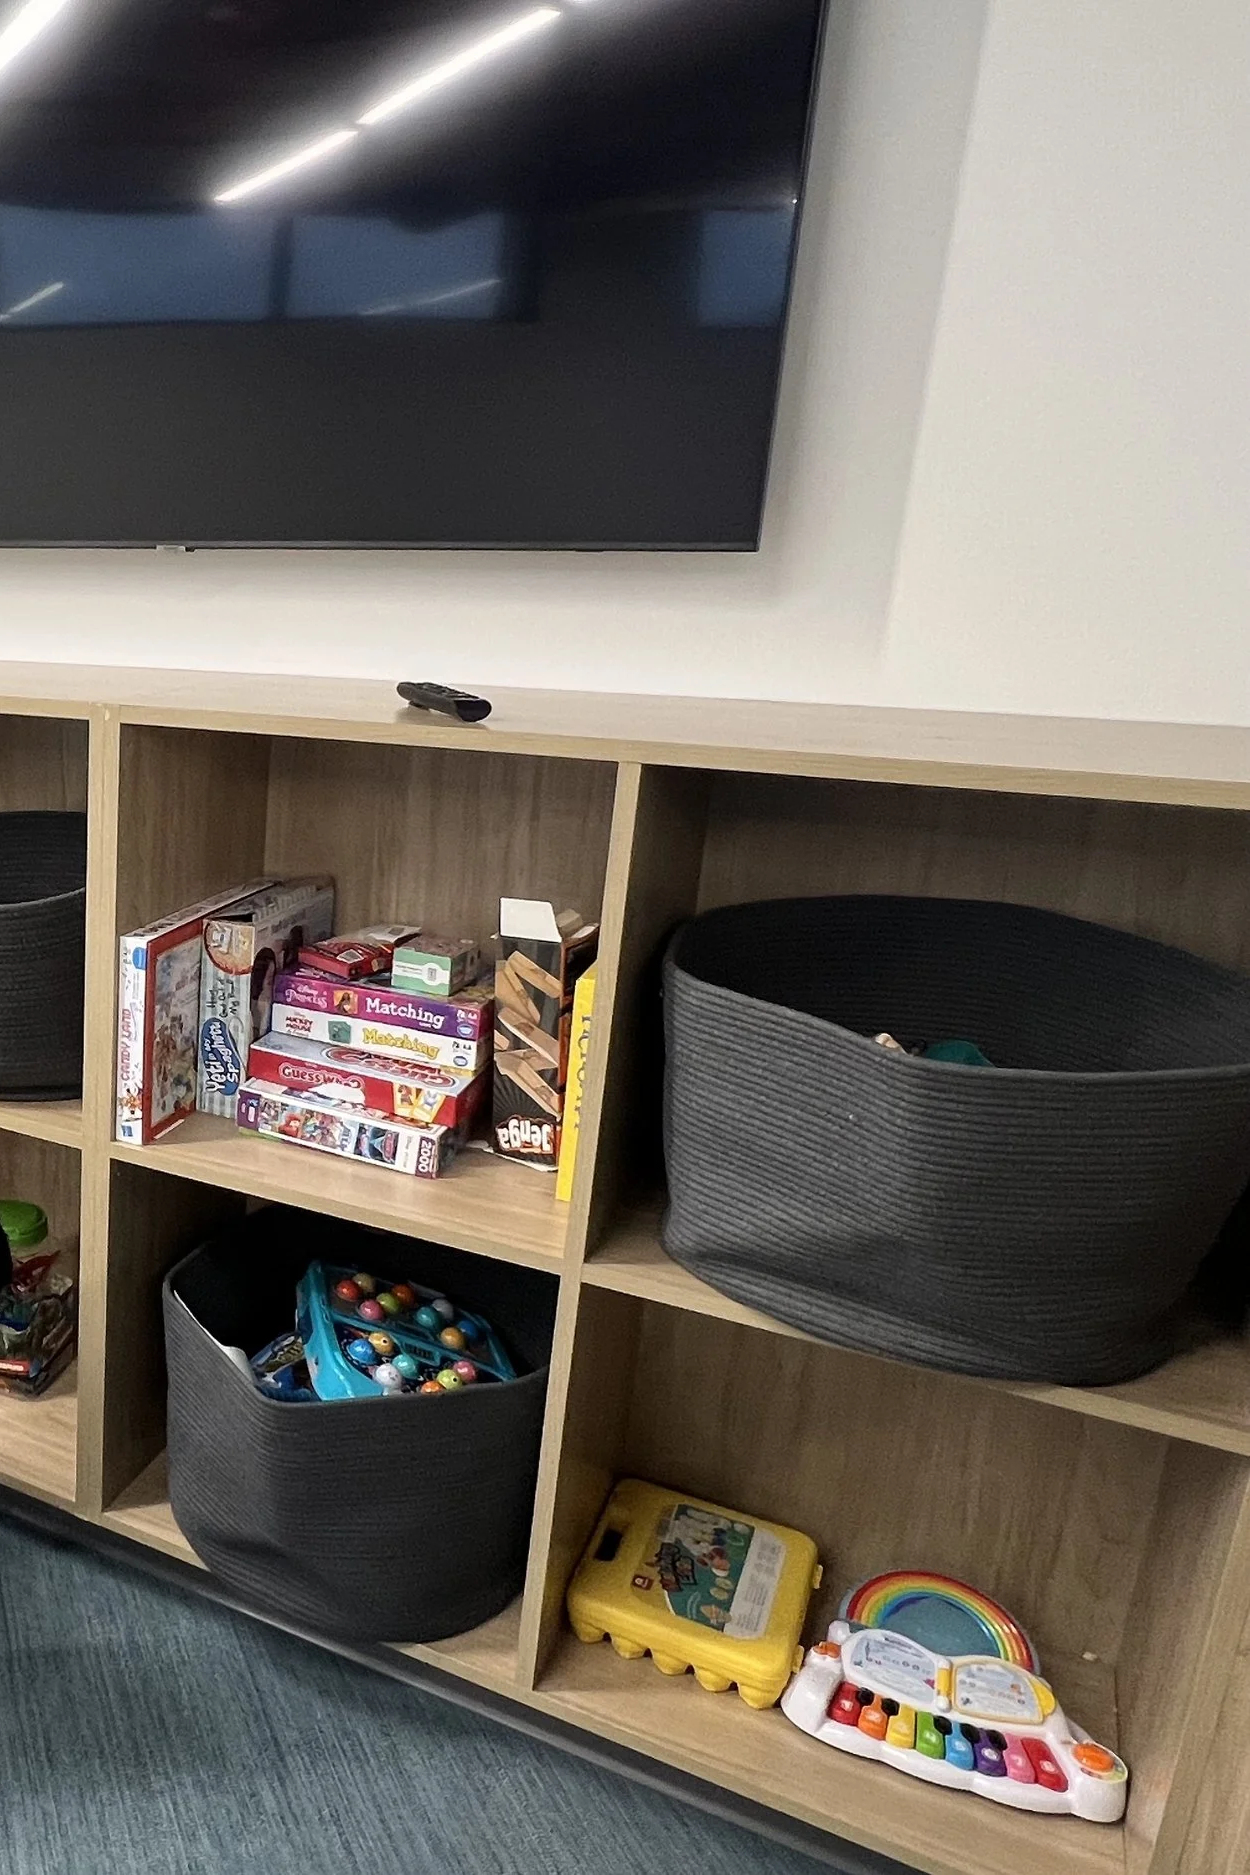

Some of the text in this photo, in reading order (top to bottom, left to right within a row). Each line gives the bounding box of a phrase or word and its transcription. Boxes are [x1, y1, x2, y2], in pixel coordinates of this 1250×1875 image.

[365, 997, 446, 1030] Matching
[120, 1008, 132, 1081] CANDY LAND
[209, 1021, 240, 1083] Spaghetti
[362, 1027, 441, 1060] Matching
[205, 1061, 226, 1092] Yeti
[497, 1118, 552, 1152] Jenga
[418, 1139, 434, 1173] 2000
